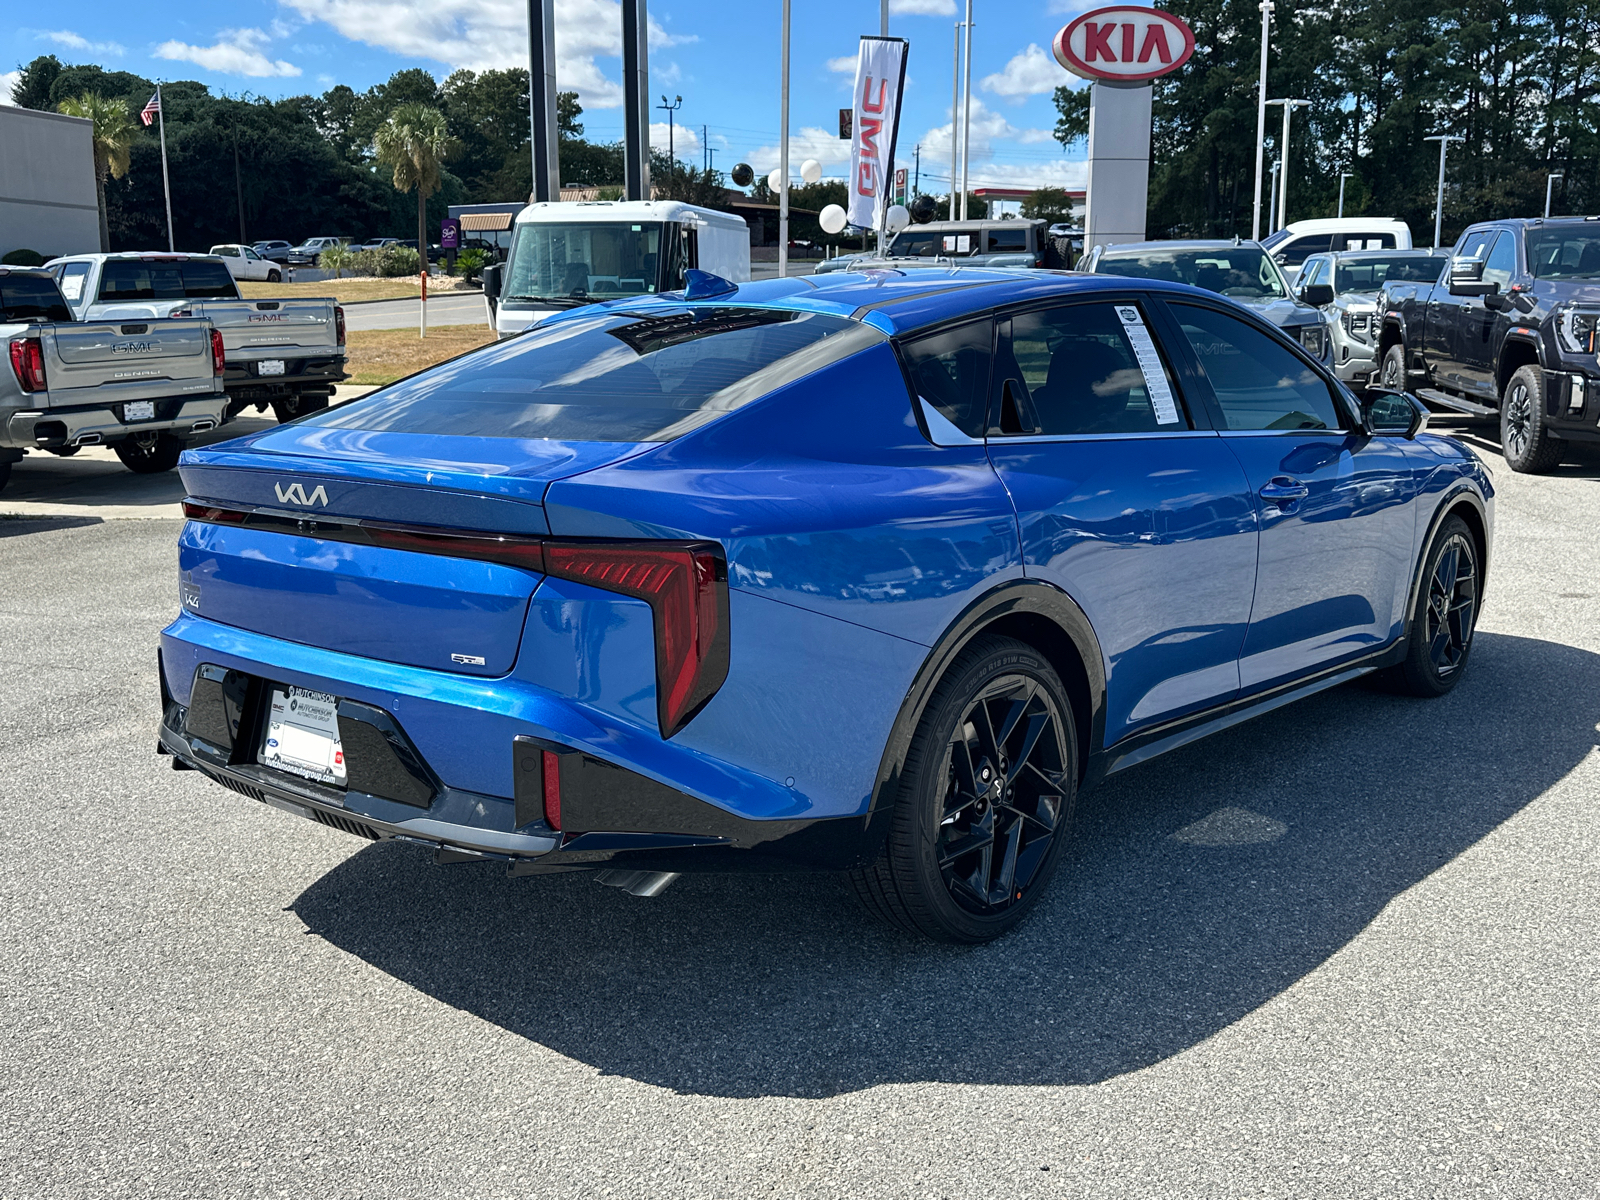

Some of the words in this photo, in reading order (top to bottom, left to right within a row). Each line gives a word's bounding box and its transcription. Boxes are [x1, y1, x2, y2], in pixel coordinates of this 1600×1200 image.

[1084, 23, 1172, 63] KIA
[858, 76, 888, 198] GMC
[248, 314, 290, 323] GMC
[111, 342, 162, 355] GMC
[114, 370, 161, 378] DENALI
[988, 658, 1002, 671] R18
[1002, 655, 1018, 667] 91W
[296, 687, 336, 704] HUTCHINSON
[297, 703, 333, 717] HUTCHINSON
[297, 711, 318, 720] AUTOMOTIVE
[265, 756, 336, 784] Hutchinsonautogroup.com
